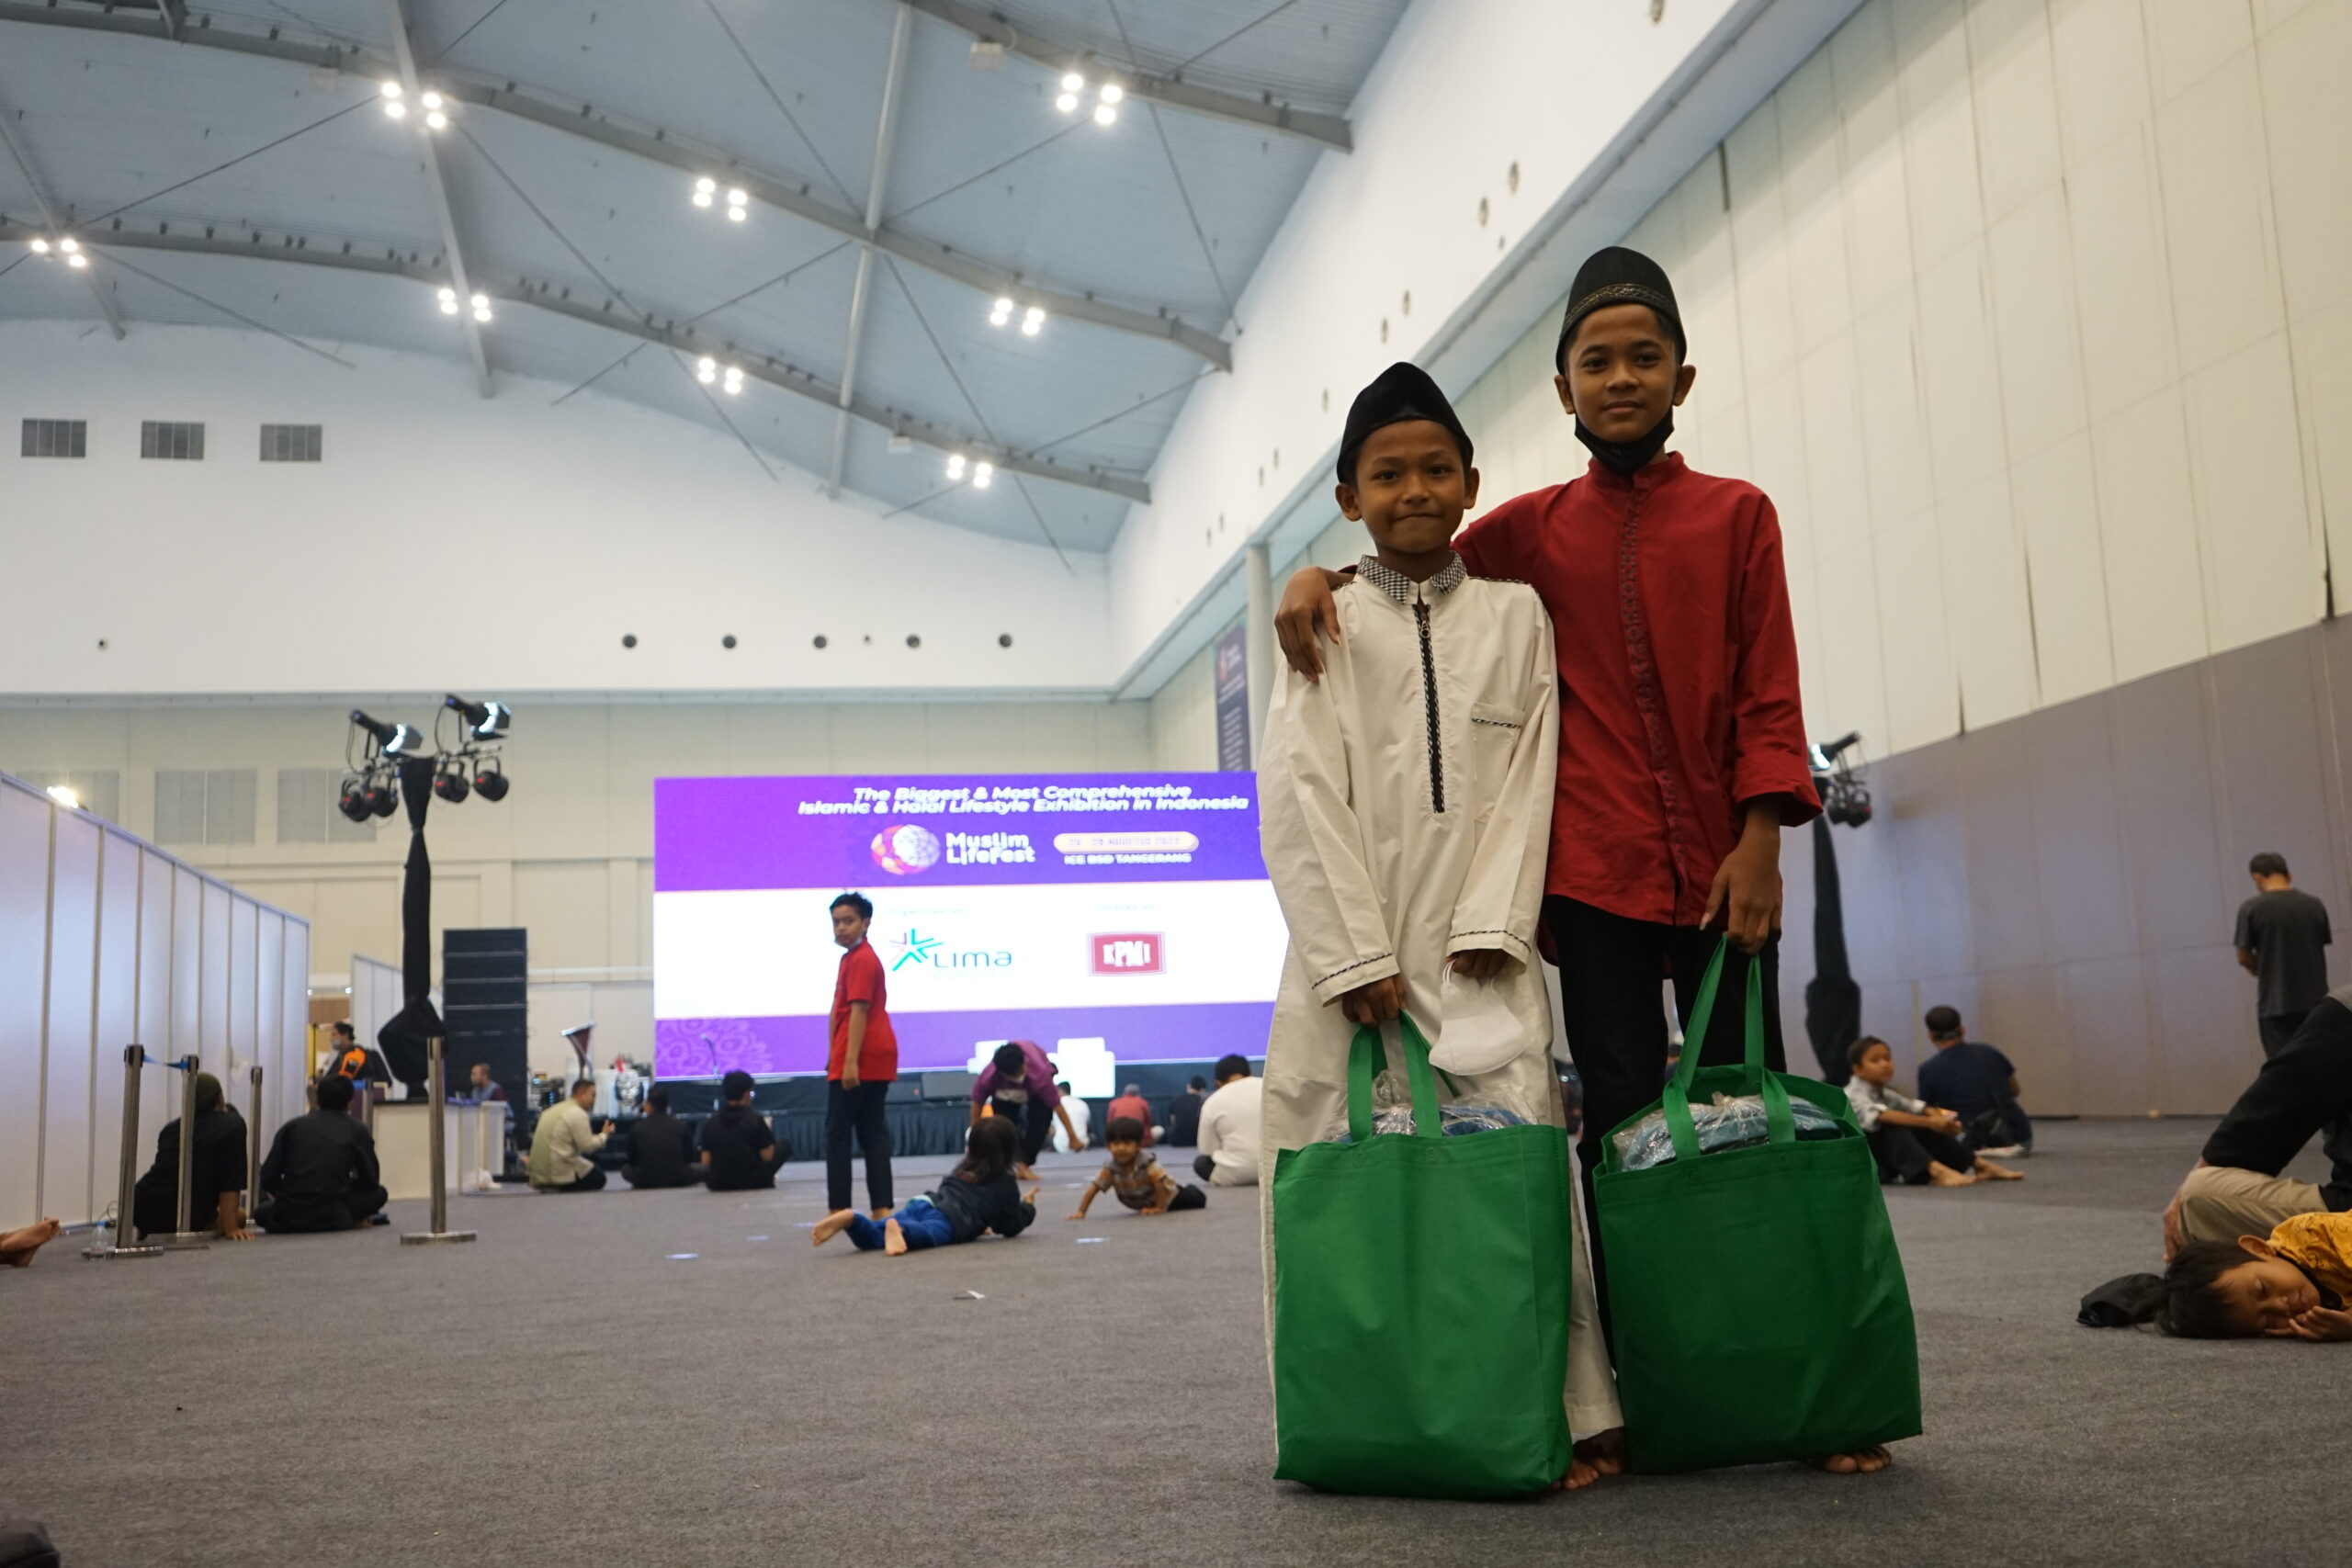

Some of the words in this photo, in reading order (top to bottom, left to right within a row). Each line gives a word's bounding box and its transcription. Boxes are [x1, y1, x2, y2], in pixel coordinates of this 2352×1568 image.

[854, 787, 891, 801] The
[894, 786, 970, 802] Biggest
[973, 786, 989, 800] &
[991, 785, 1040, 800] Most
[1044, 784, 1192, 800] Comprehensive
[797, 800, 871, 815] Islamic
[873, 801, 888, 814] &
[892, 799, 945, 814] Halal
[948, 798, 1030, 815] Lifestyle
[1033, 797, 1129, 812] Exhibition
[1133, 796, 1152, 810] in
[1155, 795, 1250, 811] Indonesia
[945, 831, 1029, 848] Muslim
[946, 846, 1035, 864] LifeFest
